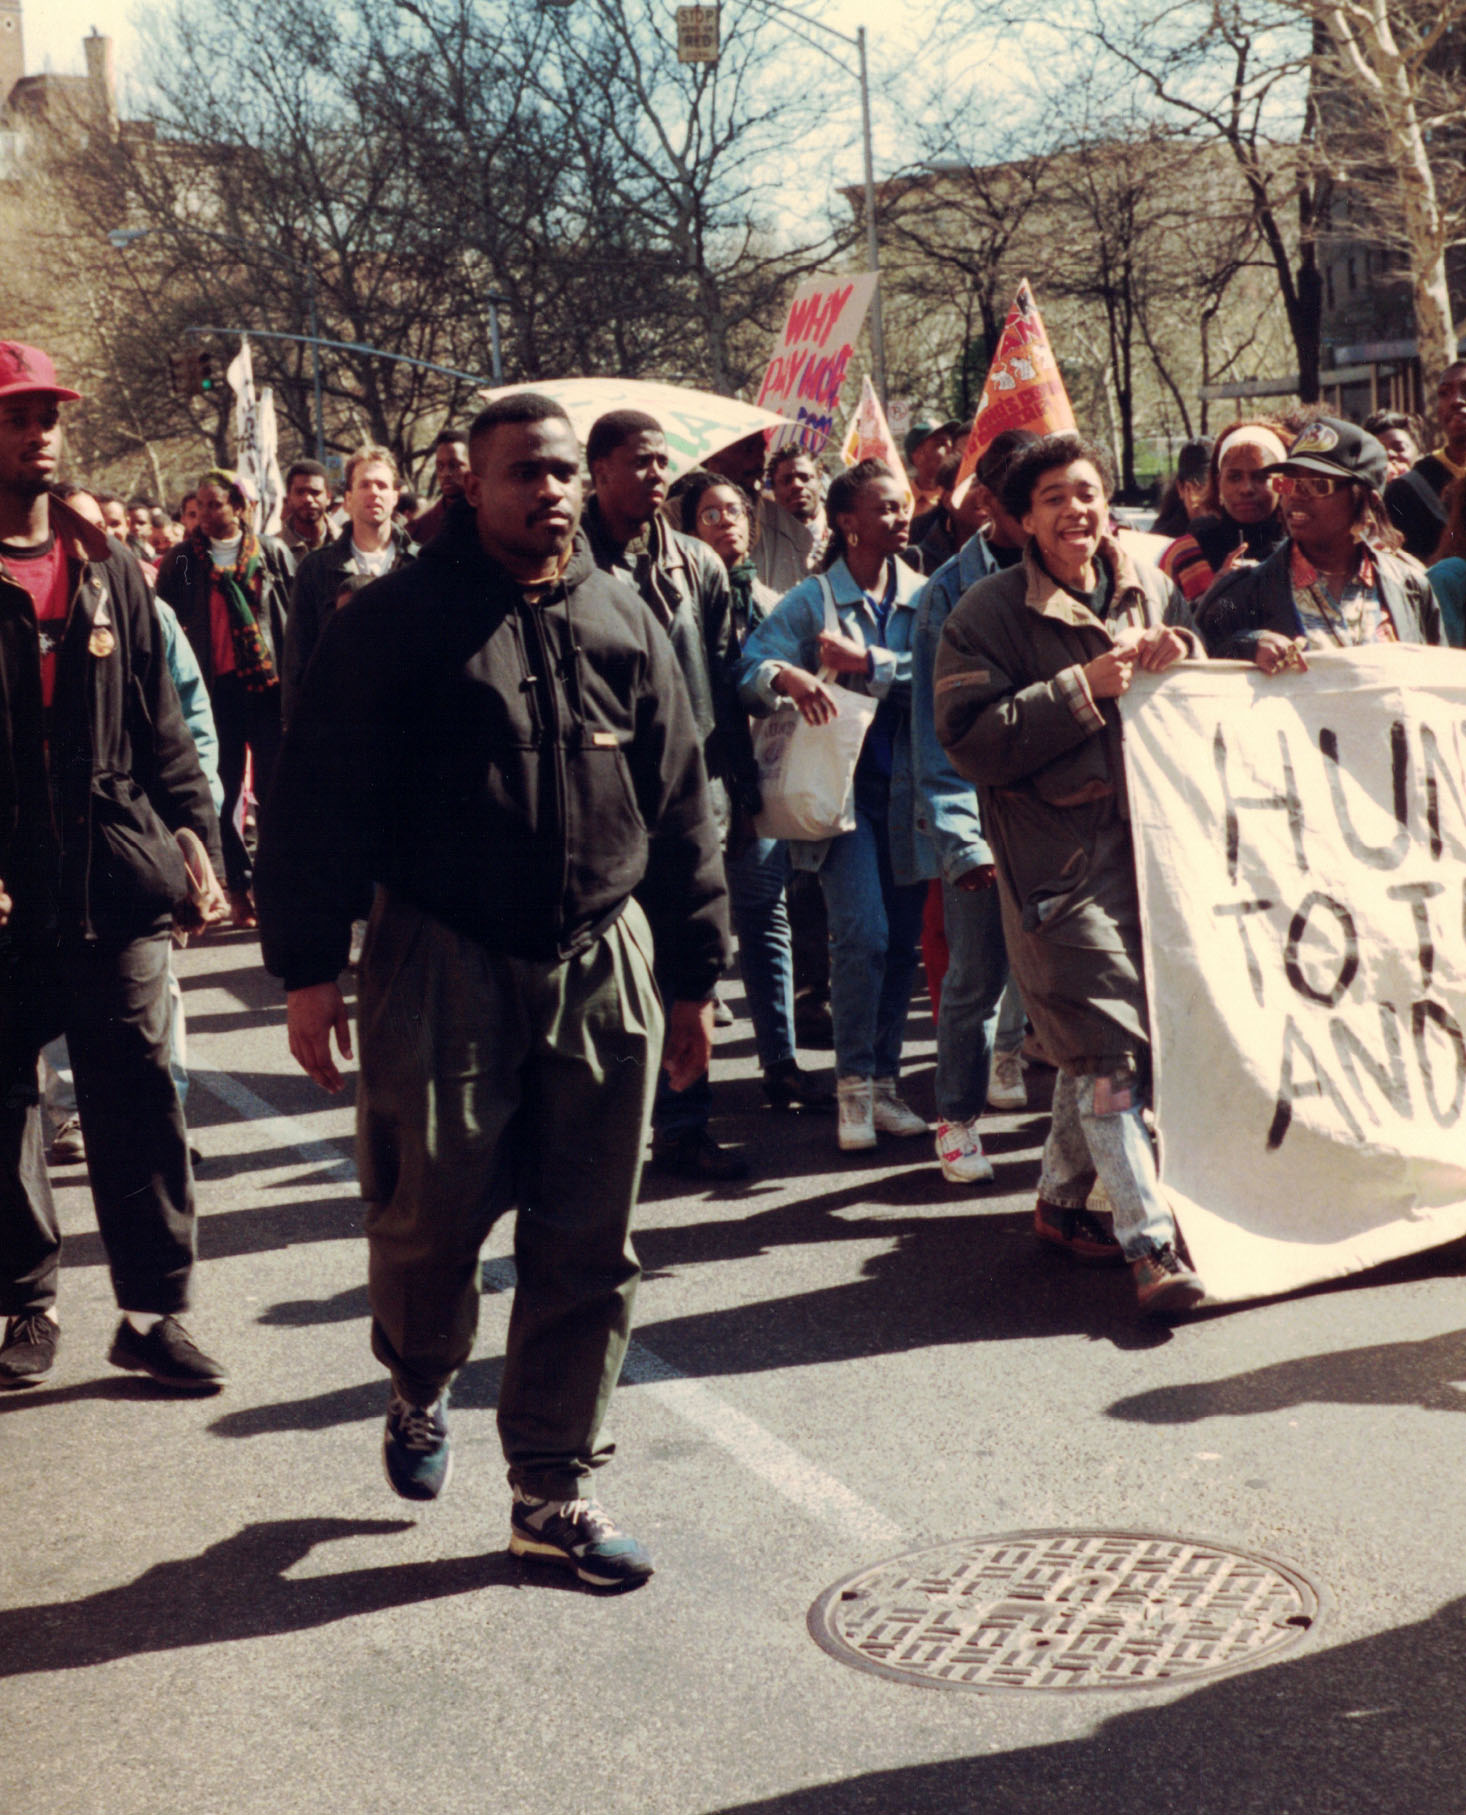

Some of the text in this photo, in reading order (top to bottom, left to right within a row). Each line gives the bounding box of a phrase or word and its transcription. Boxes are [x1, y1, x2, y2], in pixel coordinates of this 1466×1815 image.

[681, 10, 714, 24] STOP
[785, 283, 854, 347] WHY
[757, 348, 808, 407] PAY
[1213, 891, 1358, 1009] TO
[1266, 997, 1466, 1153] AND
